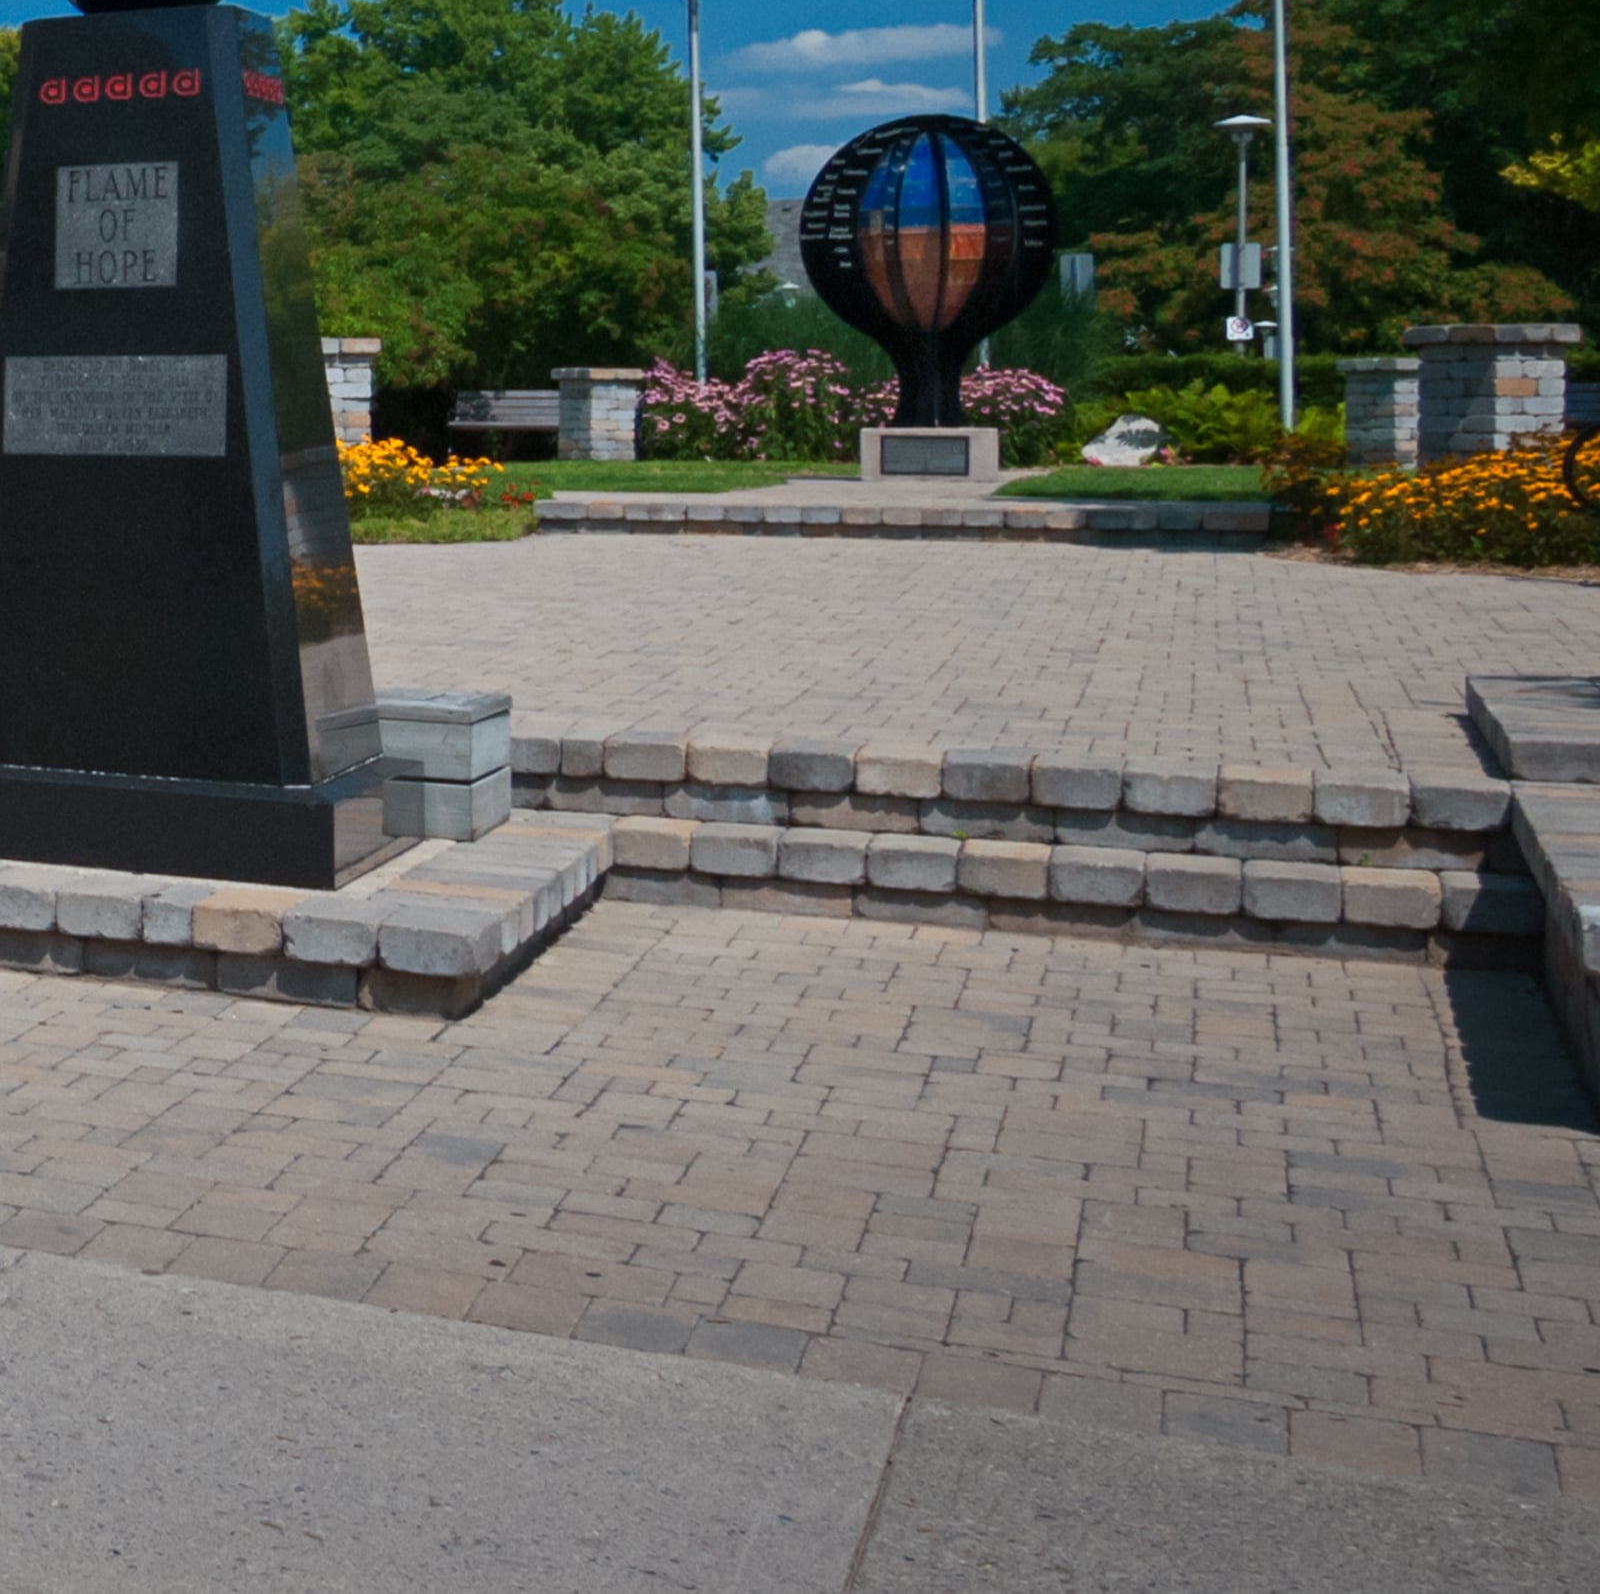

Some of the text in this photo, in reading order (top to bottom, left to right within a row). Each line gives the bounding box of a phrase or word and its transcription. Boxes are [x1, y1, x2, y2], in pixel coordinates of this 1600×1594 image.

[68, 167, 168, 203] FLAME
[99, 209, 136, 243] OF
[75, 249, 156, 285] HOPE
